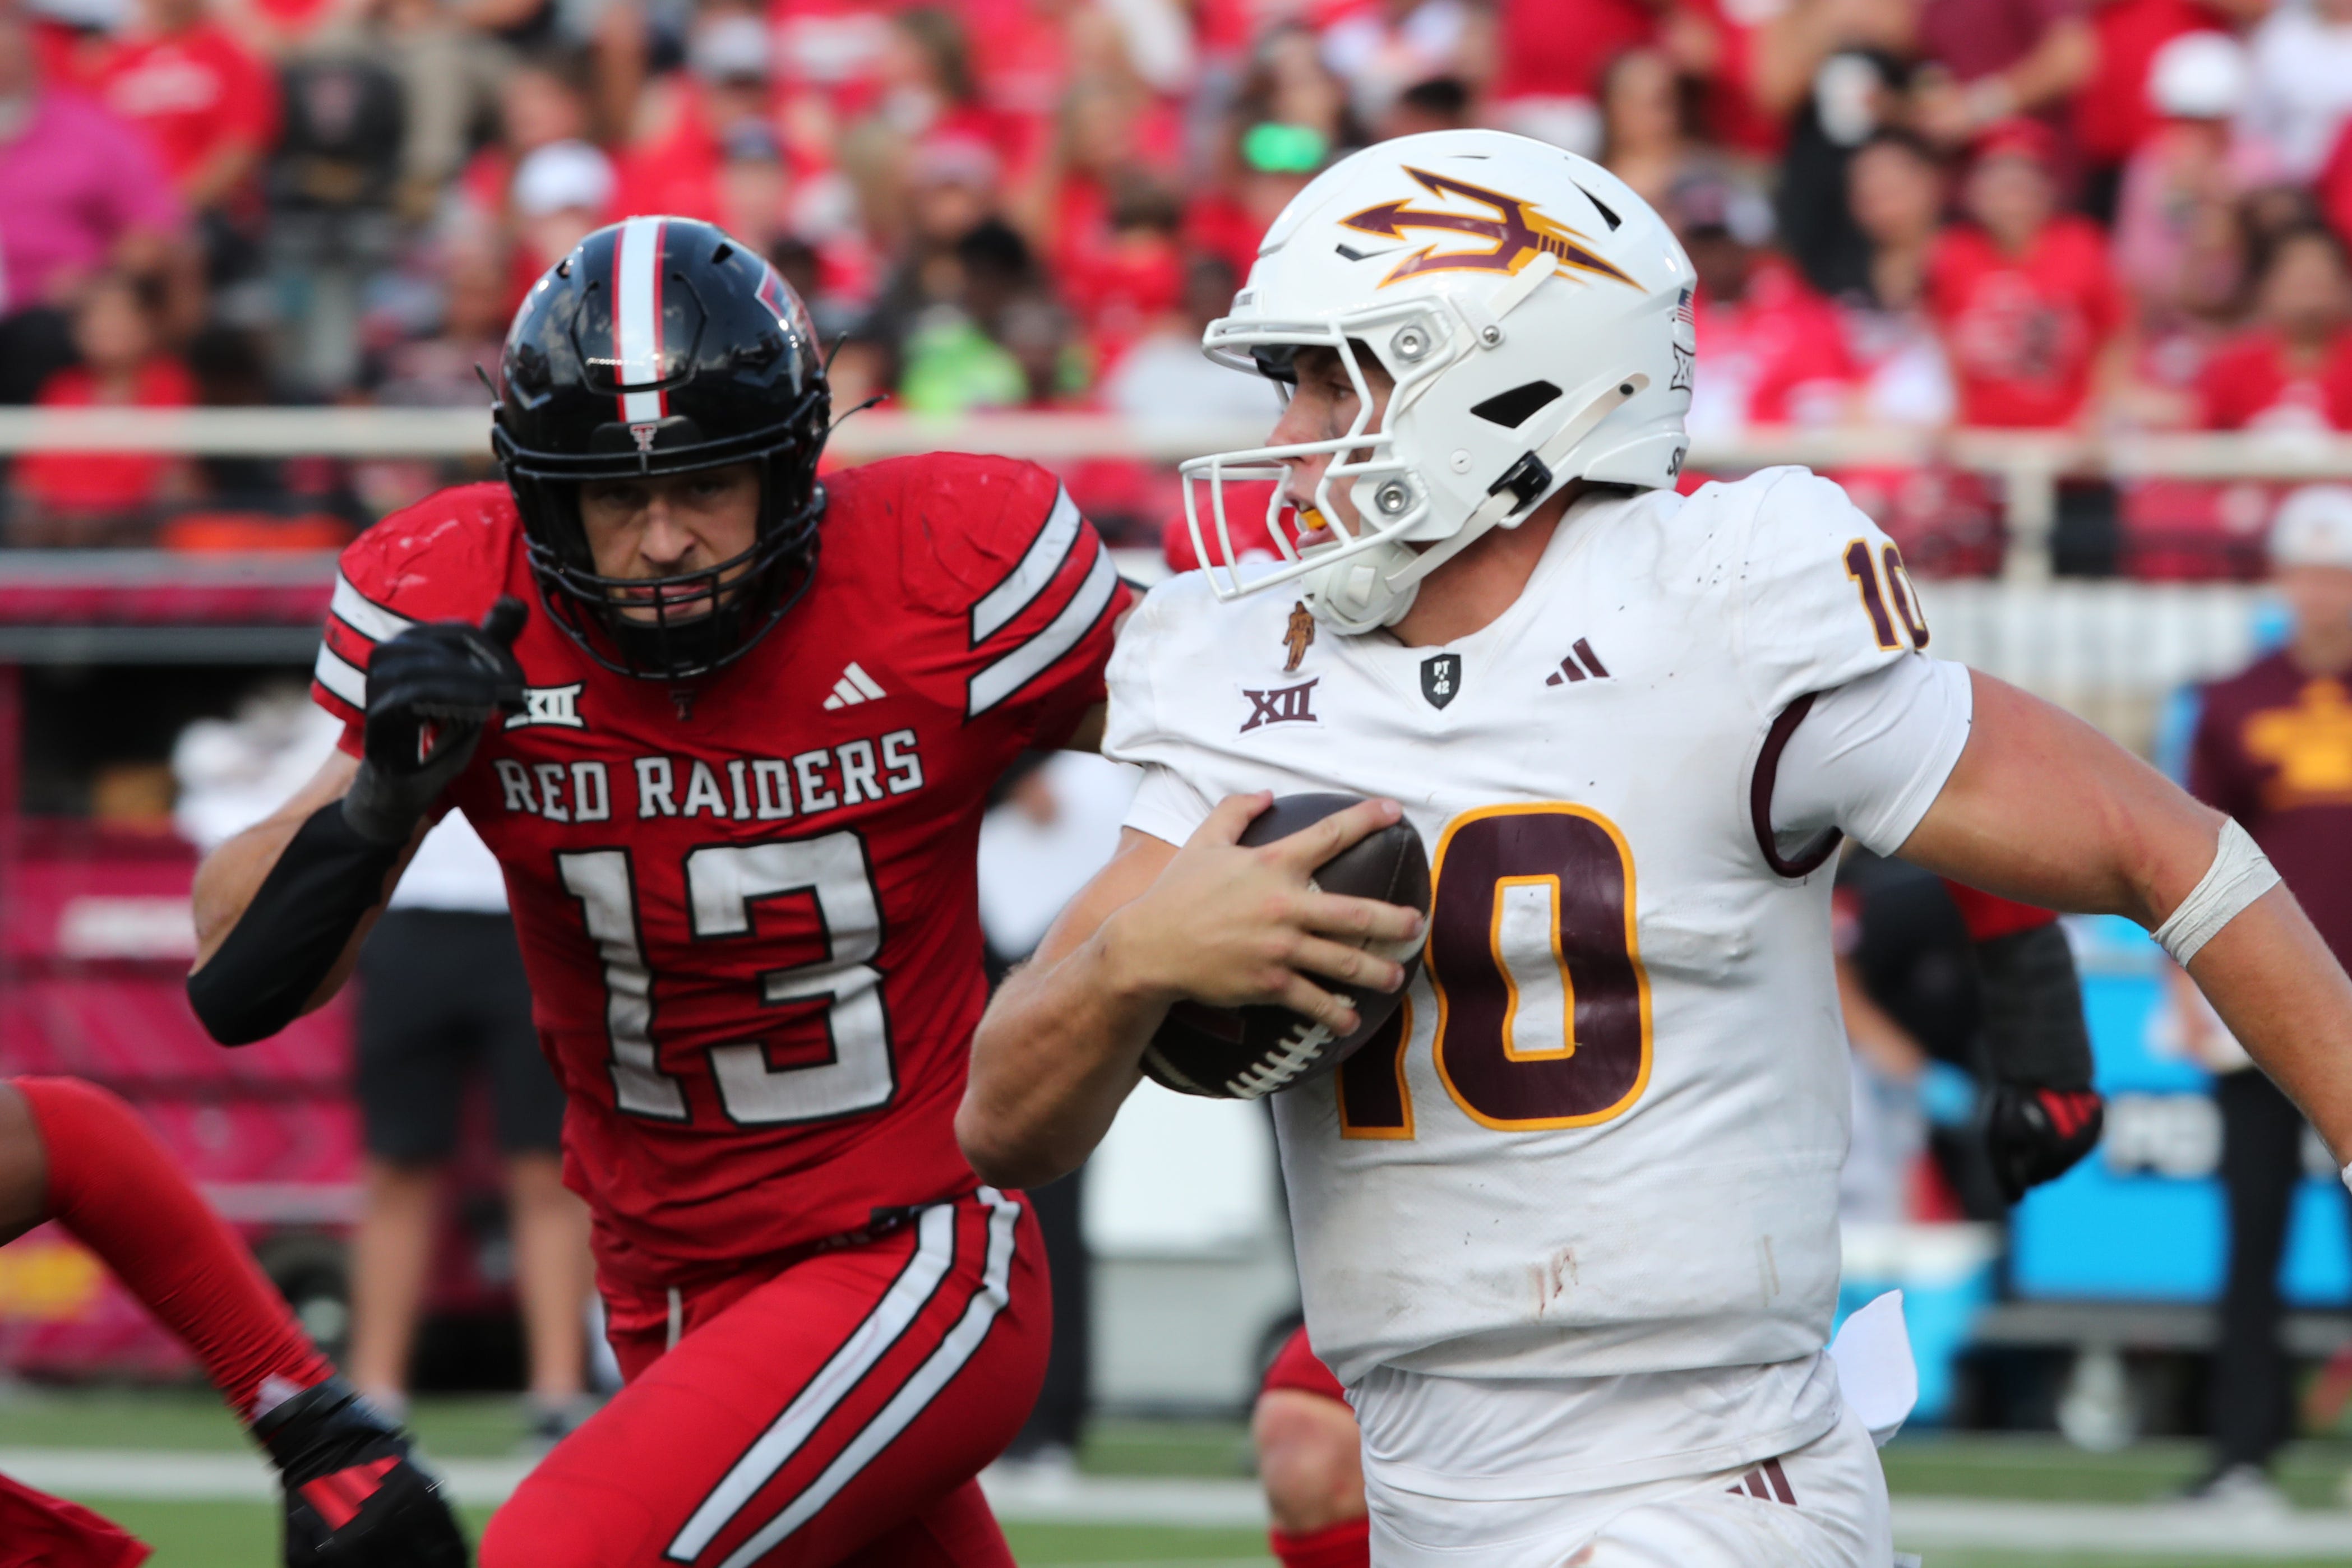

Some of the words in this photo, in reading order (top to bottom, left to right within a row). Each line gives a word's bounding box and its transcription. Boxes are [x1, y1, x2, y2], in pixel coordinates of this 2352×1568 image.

[1841, 535, 1931, 652] 10
[1240, 677, 1319, 733] XII
[1433, 680, 1450, 695] 42
[1434, 660, 1450, 676] PT
[493, 759, 611, 823] RED
[634, 729, 923, 821] RAIDERS
[554, 830, 896, 1125] 13
